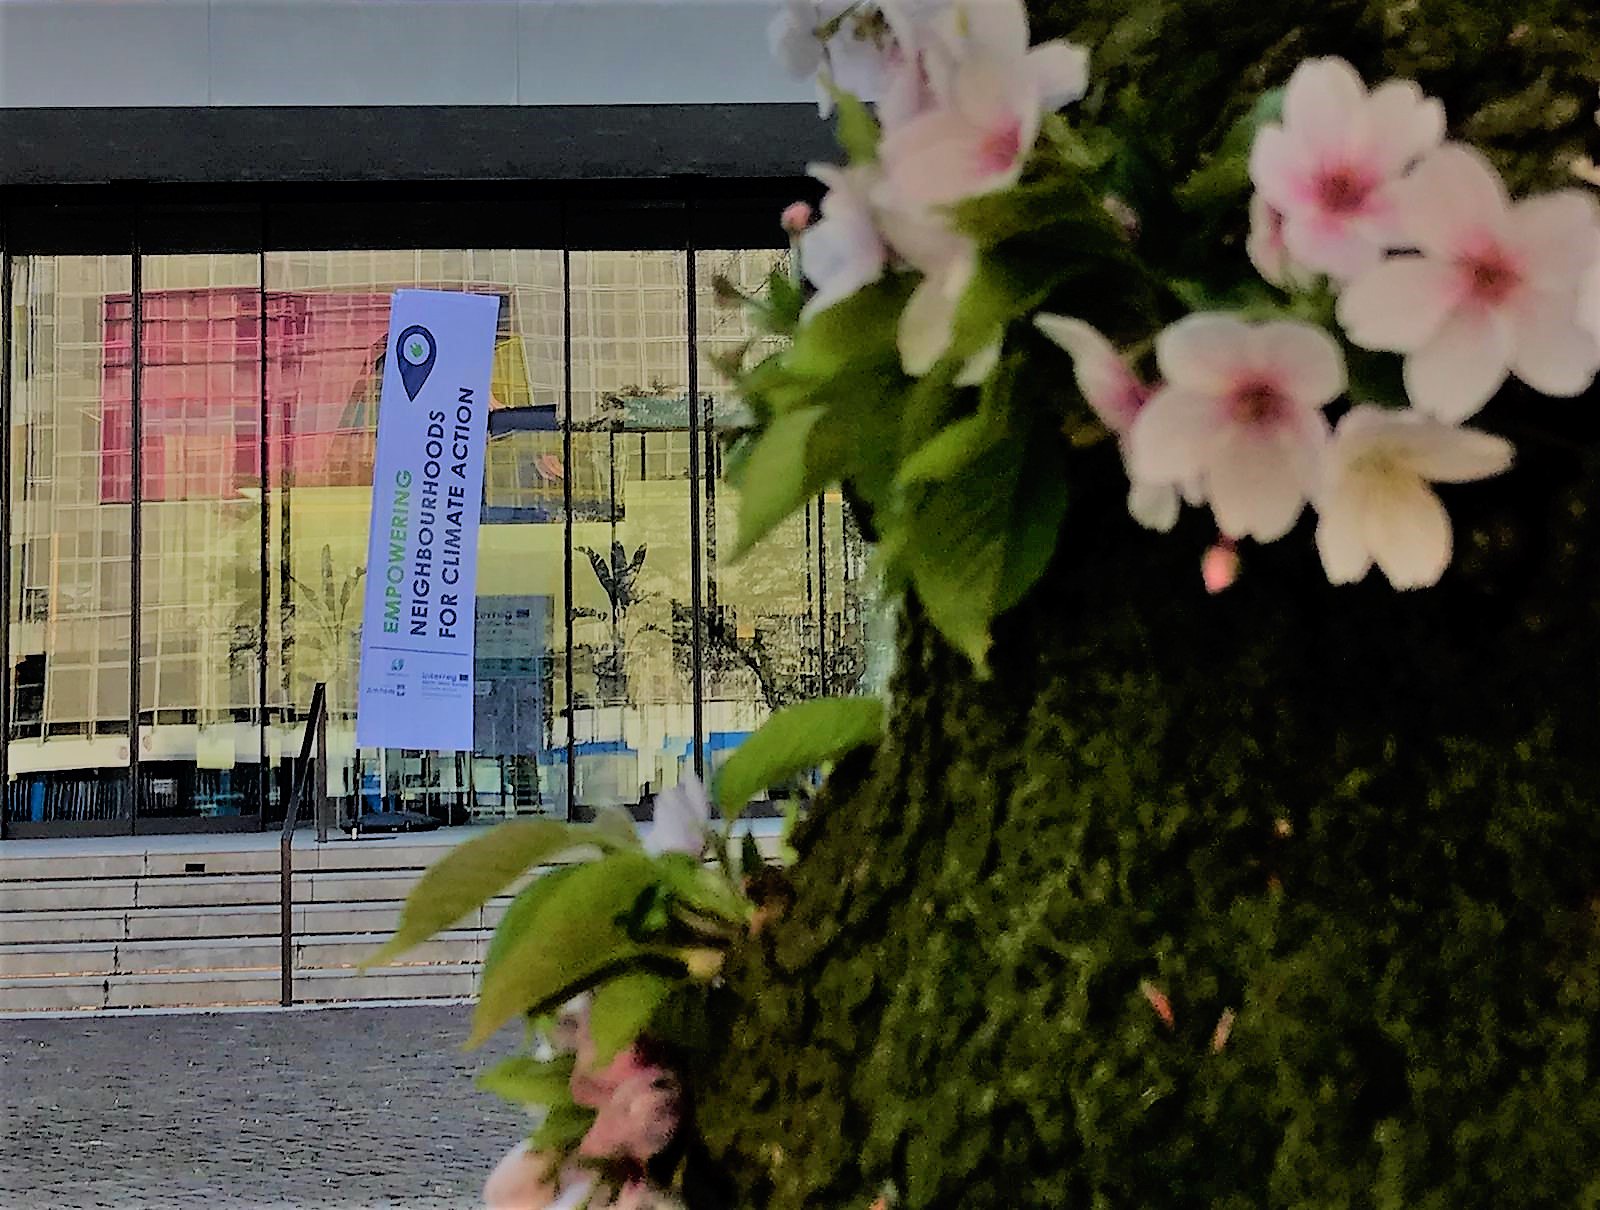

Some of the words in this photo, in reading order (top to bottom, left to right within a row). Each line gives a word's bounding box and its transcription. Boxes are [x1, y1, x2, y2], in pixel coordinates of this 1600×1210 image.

[450, 387, 474, 480] ACTION
[383, 470, 412, 634] EMPOWERING
[410, 410, 446, 636] NEIGHBOURHOODS
[441, 485, 465, 585] CLIMATE
[439, 593, 458, 639] FOR
